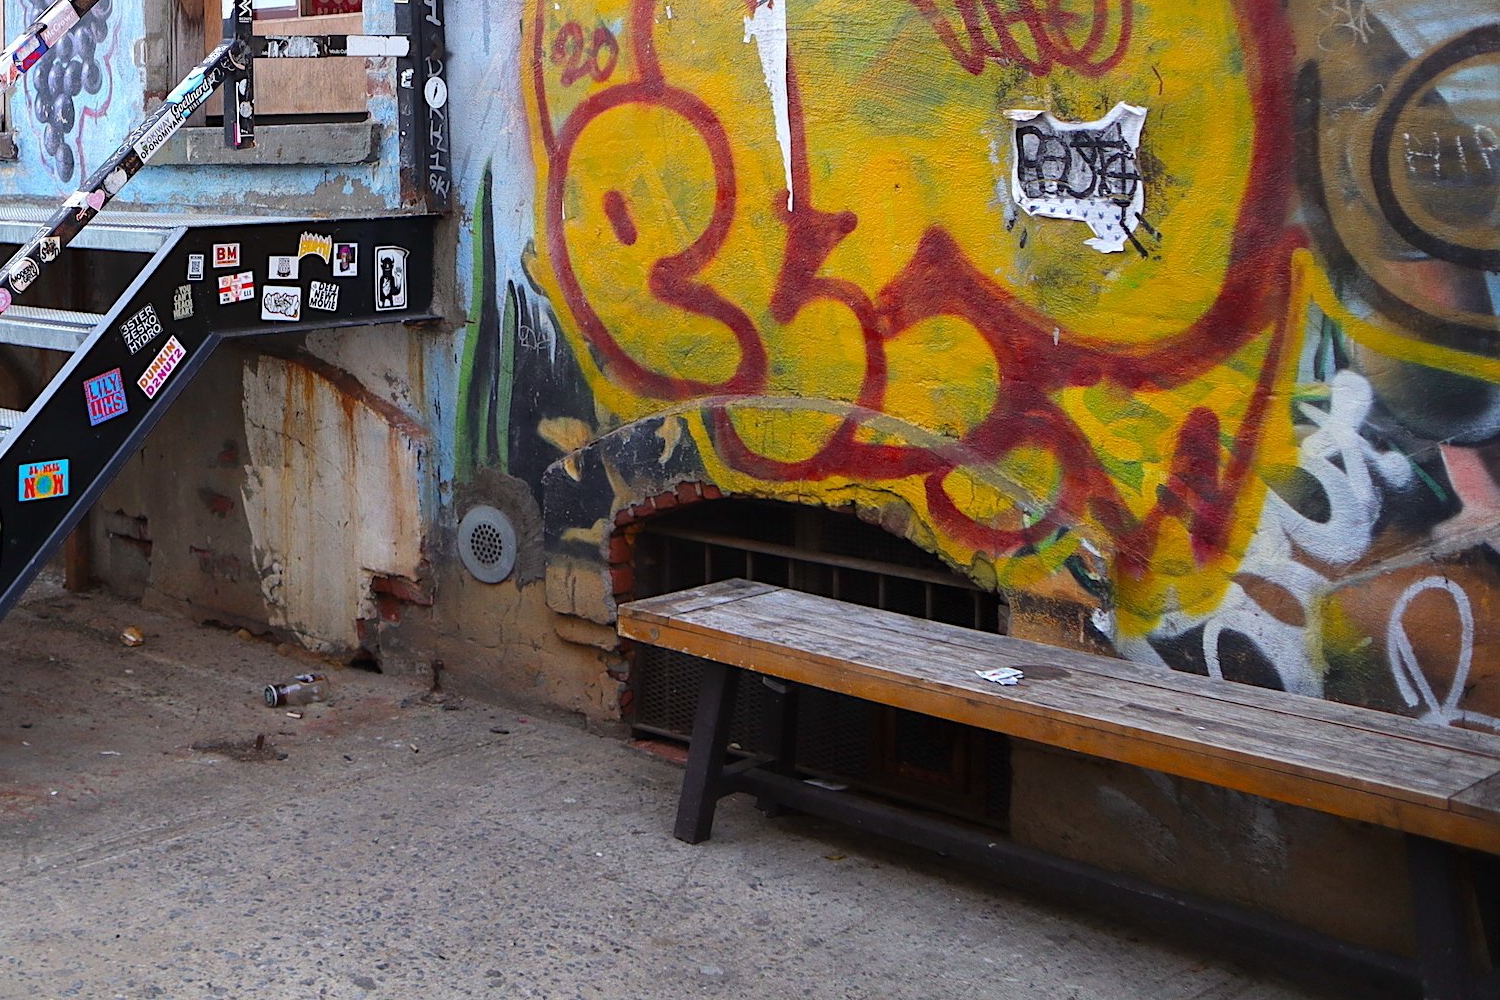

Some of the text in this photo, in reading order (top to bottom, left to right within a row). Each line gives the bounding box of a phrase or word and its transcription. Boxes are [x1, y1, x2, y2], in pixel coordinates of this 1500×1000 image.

[43, 10, 78, 42] McCrown
[551, 21, 619, 87] 20
[216, 246, 237, 261] BM
[310, 299, 337, 310] MOVIE
[128, 324, 161, 354] HYDRO
[139, 338, 177, 388] DUNKIN'
